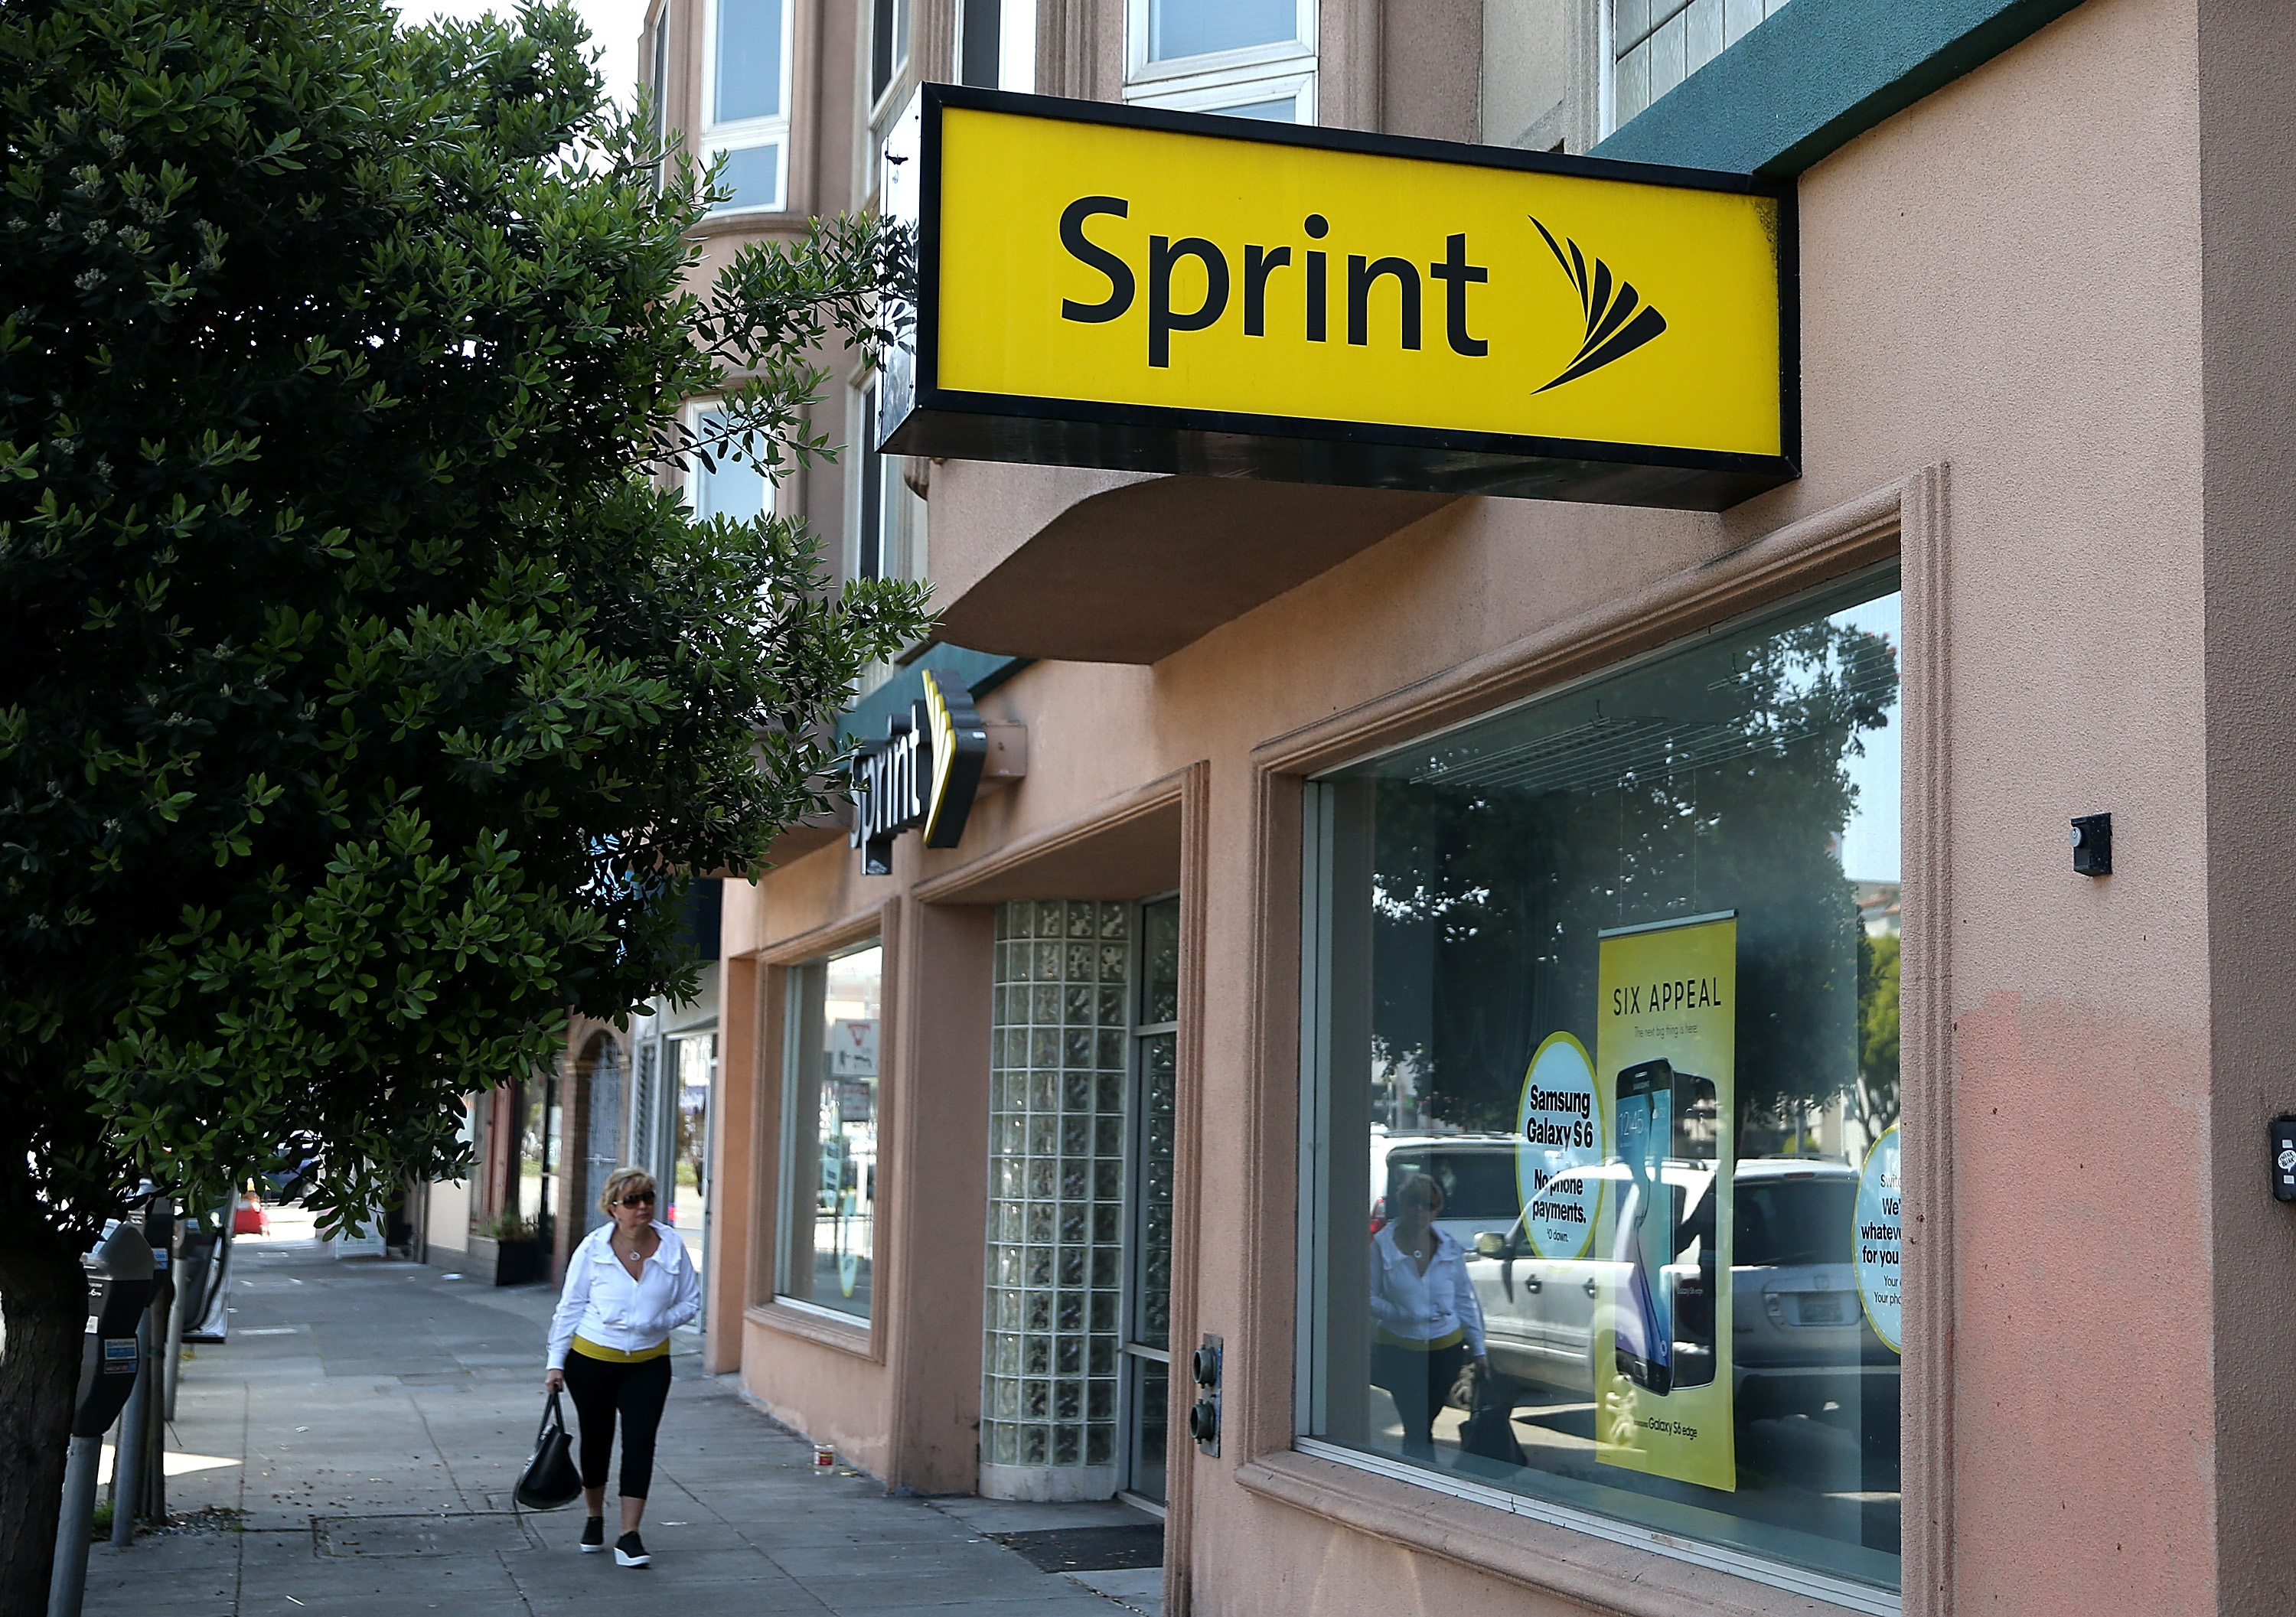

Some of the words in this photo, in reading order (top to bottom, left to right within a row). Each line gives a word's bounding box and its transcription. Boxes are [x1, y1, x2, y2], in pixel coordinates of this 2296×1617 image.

[1060, 196, 1488, 368] Sprint
[1613, 986, 1640, 1016] SIX
[1649, 976, 1721, 1012] APPEAL
[1530, 1084, 1590, 1120] Samsung
[1527, 1117, 1572, 1152] Galaxy
[1534, 1169, 1548, 1190] No
[1550, 1171, 1583, 1196] phone
[1532, 1201, 1587, 1223] payments.
[1862, 1244, 1877, 1263] for
[1880, 1250, 1899, 1267] you
[1883, 1275, 1898, 1287] Your
[1874, 1291, 1888, 1303] Your
[1649, 1417, 1673, 1436] Galaxy
[1673, 1421, 1681, 1435] S6
[1682, 1426, 1698, 1440] edge
